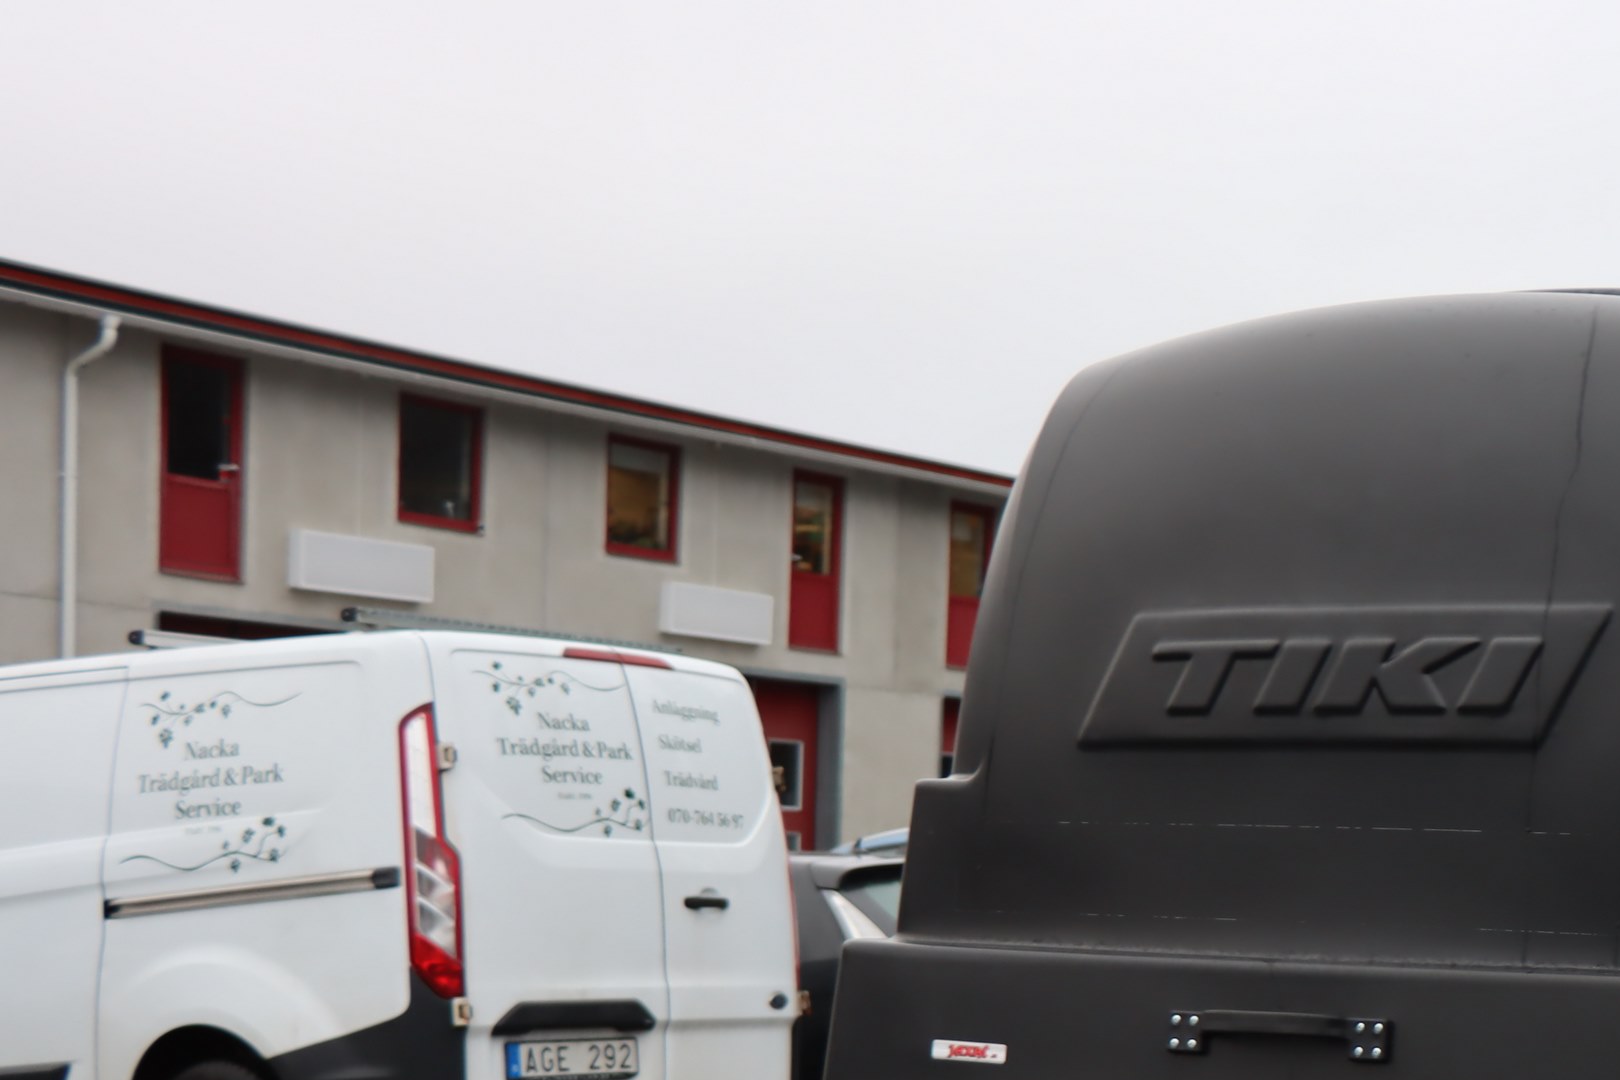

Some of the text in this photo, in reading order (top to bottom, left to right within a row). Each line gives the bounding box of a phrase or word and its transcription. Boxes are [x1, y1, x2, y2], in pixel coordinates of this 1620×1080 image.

[1151, 636, 1543, 718] TIKI
[536, 712, 592, 732] Nacka
[183, 738, 240, 761] Nacka
[496, 737, 633, 762] Trädgård & Park
[138, 762, 284, 797] Trädgård & Park
[541, 766, 603, 785] Service
[174, 797, 242, 820] Service
[525, 1043, 633, 1073] AGE 292
